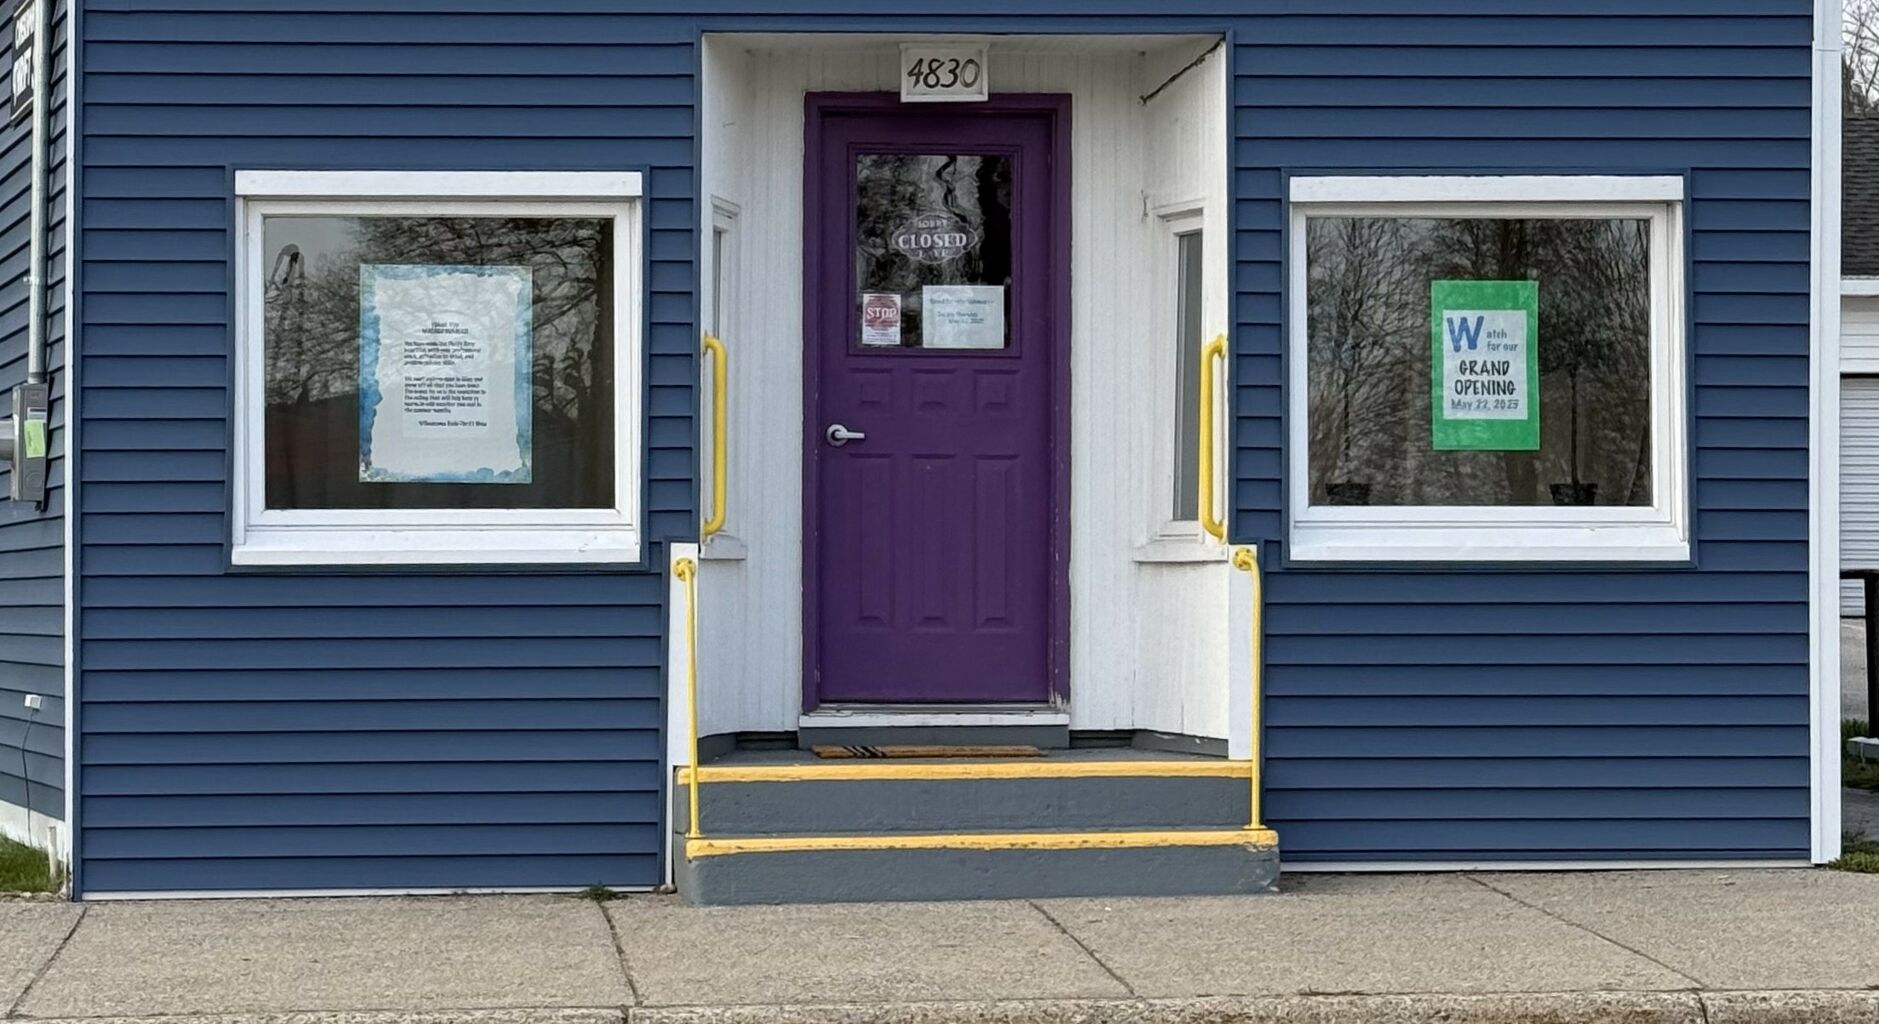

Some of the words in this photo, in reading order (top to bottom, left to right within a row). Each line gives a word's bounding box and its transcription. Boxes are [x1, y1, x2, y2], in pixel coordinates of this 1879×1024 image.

[906, 58, 980, 88] 4830
[898, 232, 967, 249] CLOSED
[866, 307, 897, 320] STOP
[1487, 341, 1501, 352] for
[1503, 342, 1518, 352] our
[1459, 360, 1510, 377] GRAND
[1454, 379, 1517, 396] OPENING
[1451, 398, 1473, 411] May
